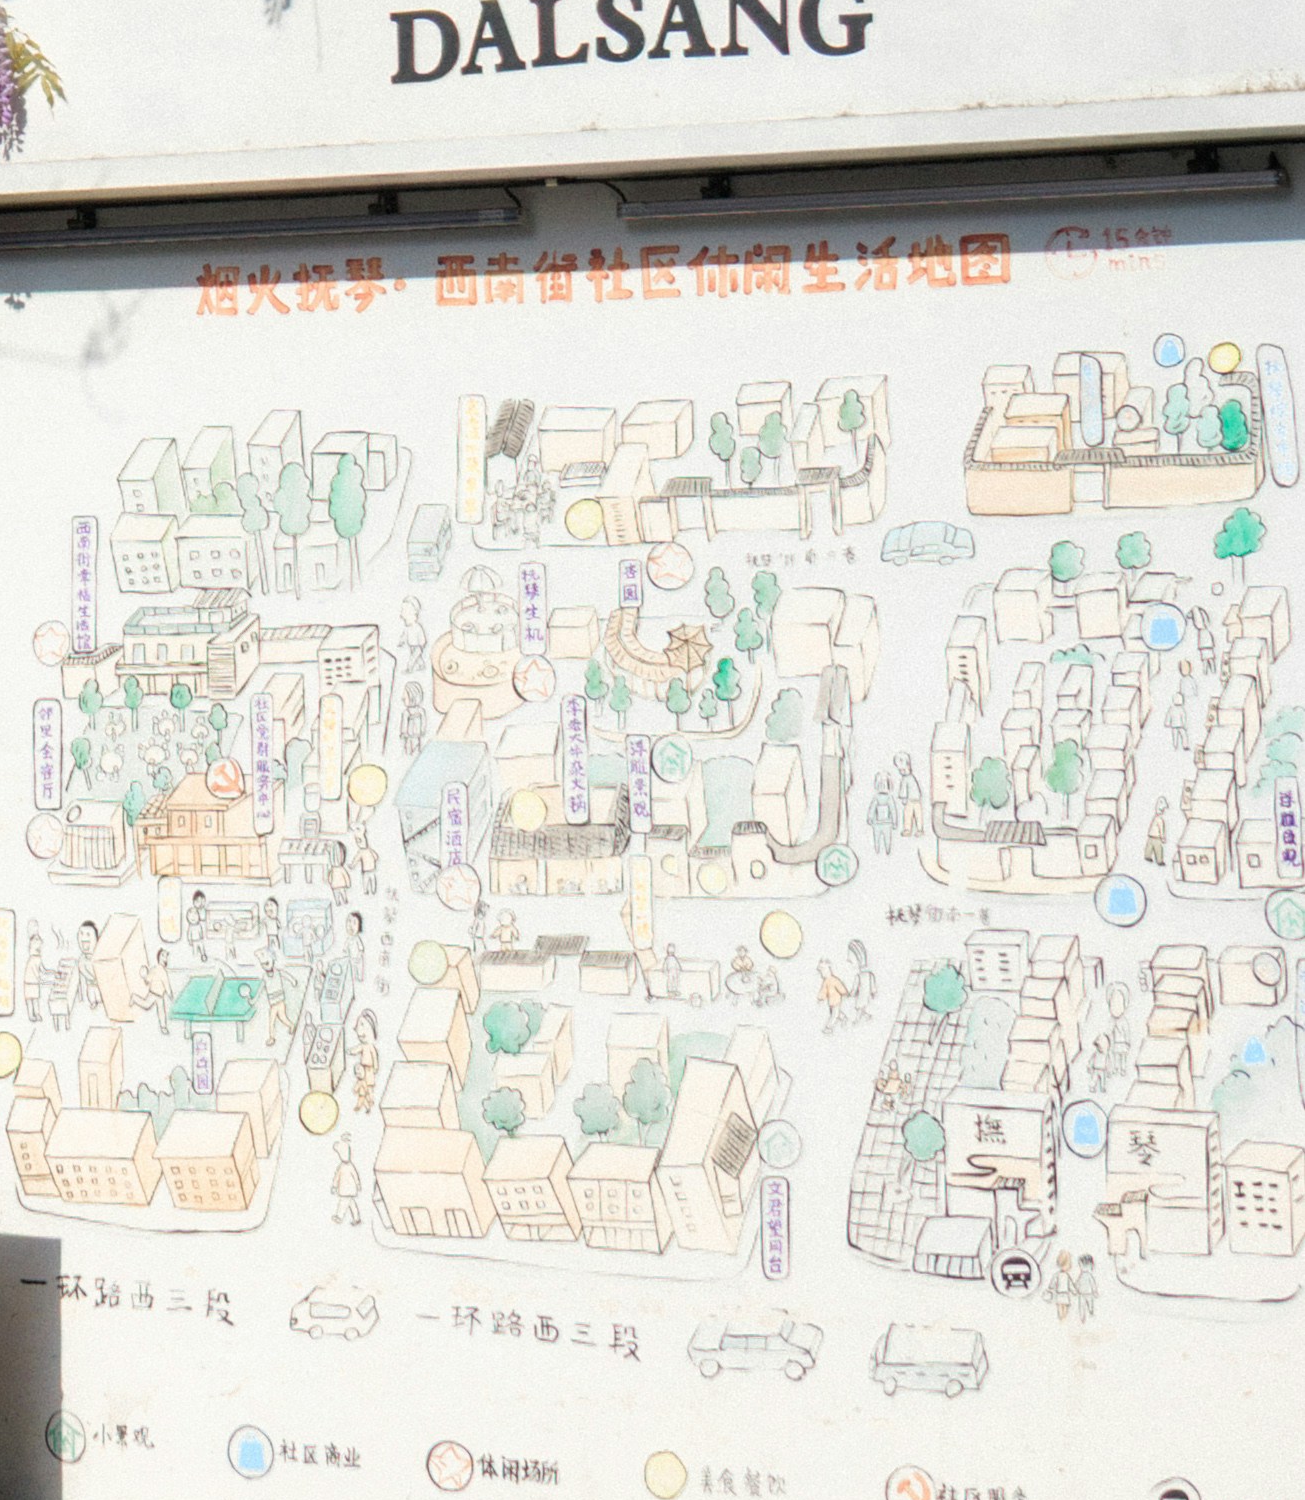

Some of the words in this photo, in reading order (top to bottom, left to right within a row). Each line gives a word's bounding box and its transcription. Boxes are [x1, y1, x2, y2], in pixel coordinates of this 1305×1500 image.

[20, 1274, 234, 1326] 一环路西三段
[416, 1306, 641, 1362] 一环路西三段
[92, 1424, 155, 1449] 小景观
[279, 1438, 362, 1470] 社区商业
